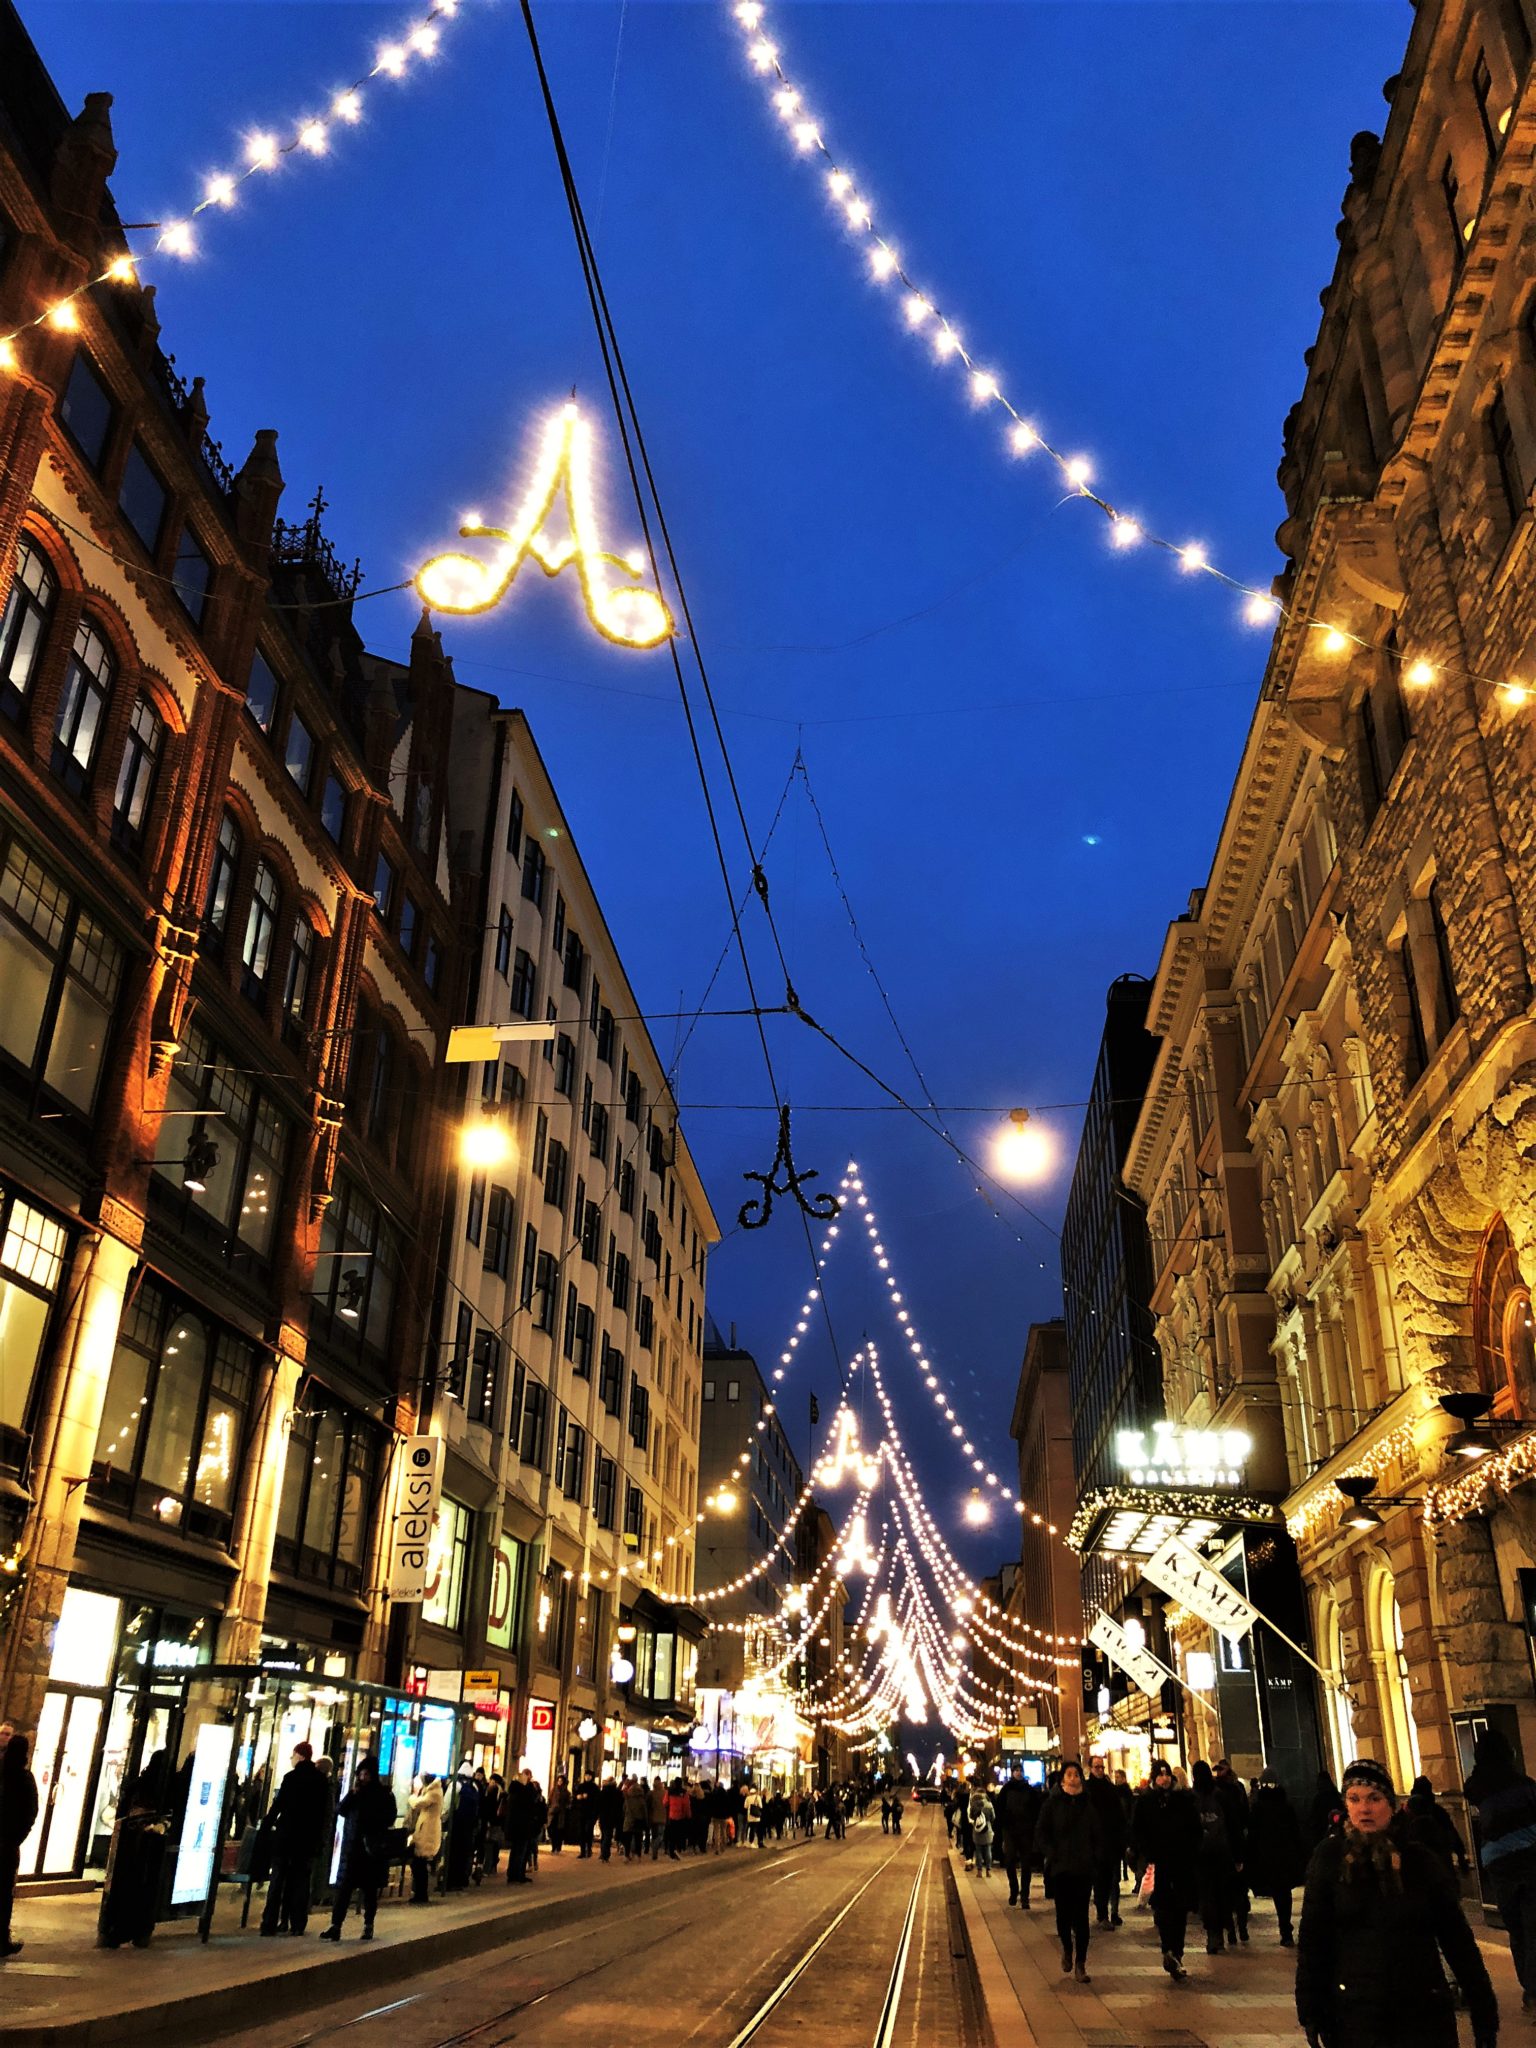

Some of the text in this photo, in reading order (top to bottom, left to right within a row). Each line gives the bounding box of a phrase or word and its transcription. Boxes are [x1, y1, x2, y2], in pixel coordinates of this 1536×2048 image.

[397, 1472, 432, 1569] aleksi
[1083, 1668, 1093, 1691] GLO
[534, 1709, 551, 1727] D
